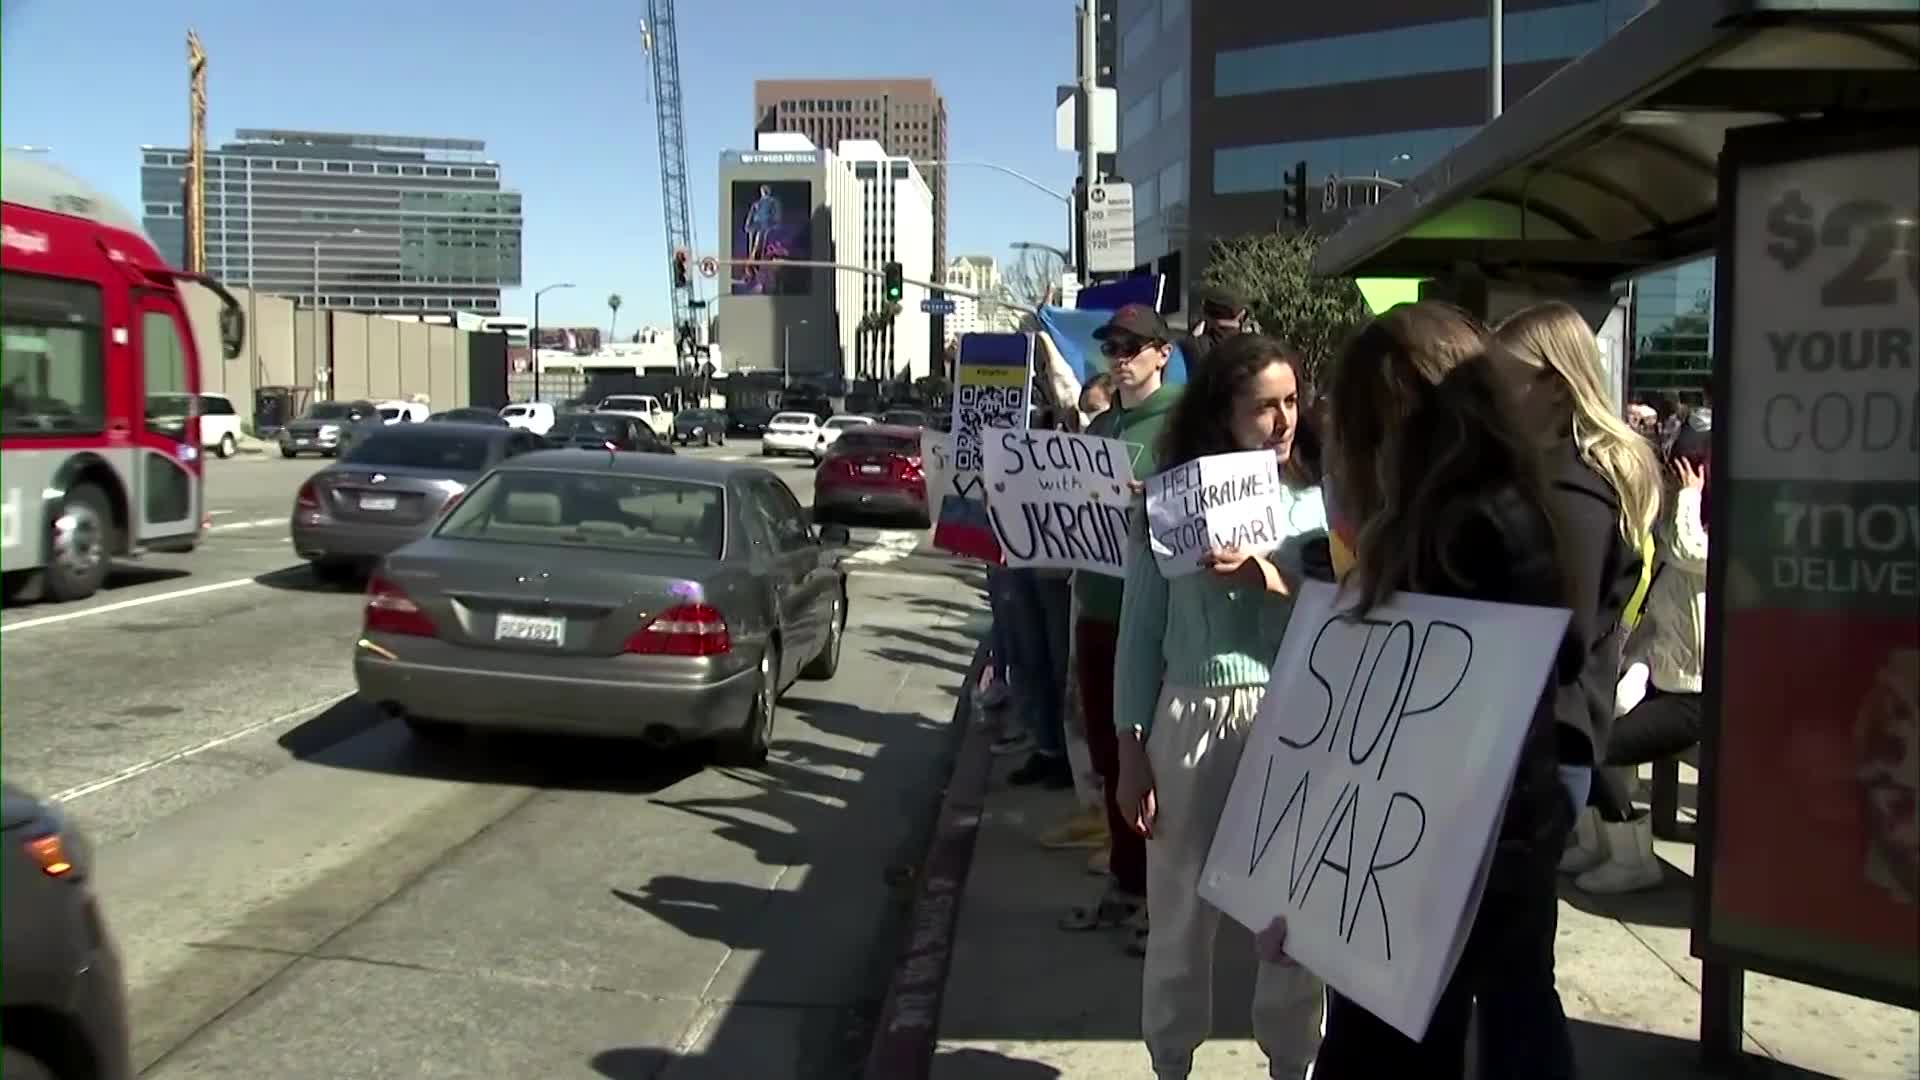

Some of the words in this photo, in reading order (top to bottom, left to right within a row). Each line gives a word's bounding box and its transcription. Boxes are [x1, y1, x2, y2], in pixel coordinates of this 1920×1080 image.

[1766, 189, 1919, 307] $2
[1765, 327, 1914, 373] YOUR
[1002, 432, 1115, 479] Stand
[1039, 474, 1082, 491] with
[1214, 506, 1277, 553] WAR!
[1279, 614, 1473, 781] STOP
[1248, 754, 1427, 961] WAR
